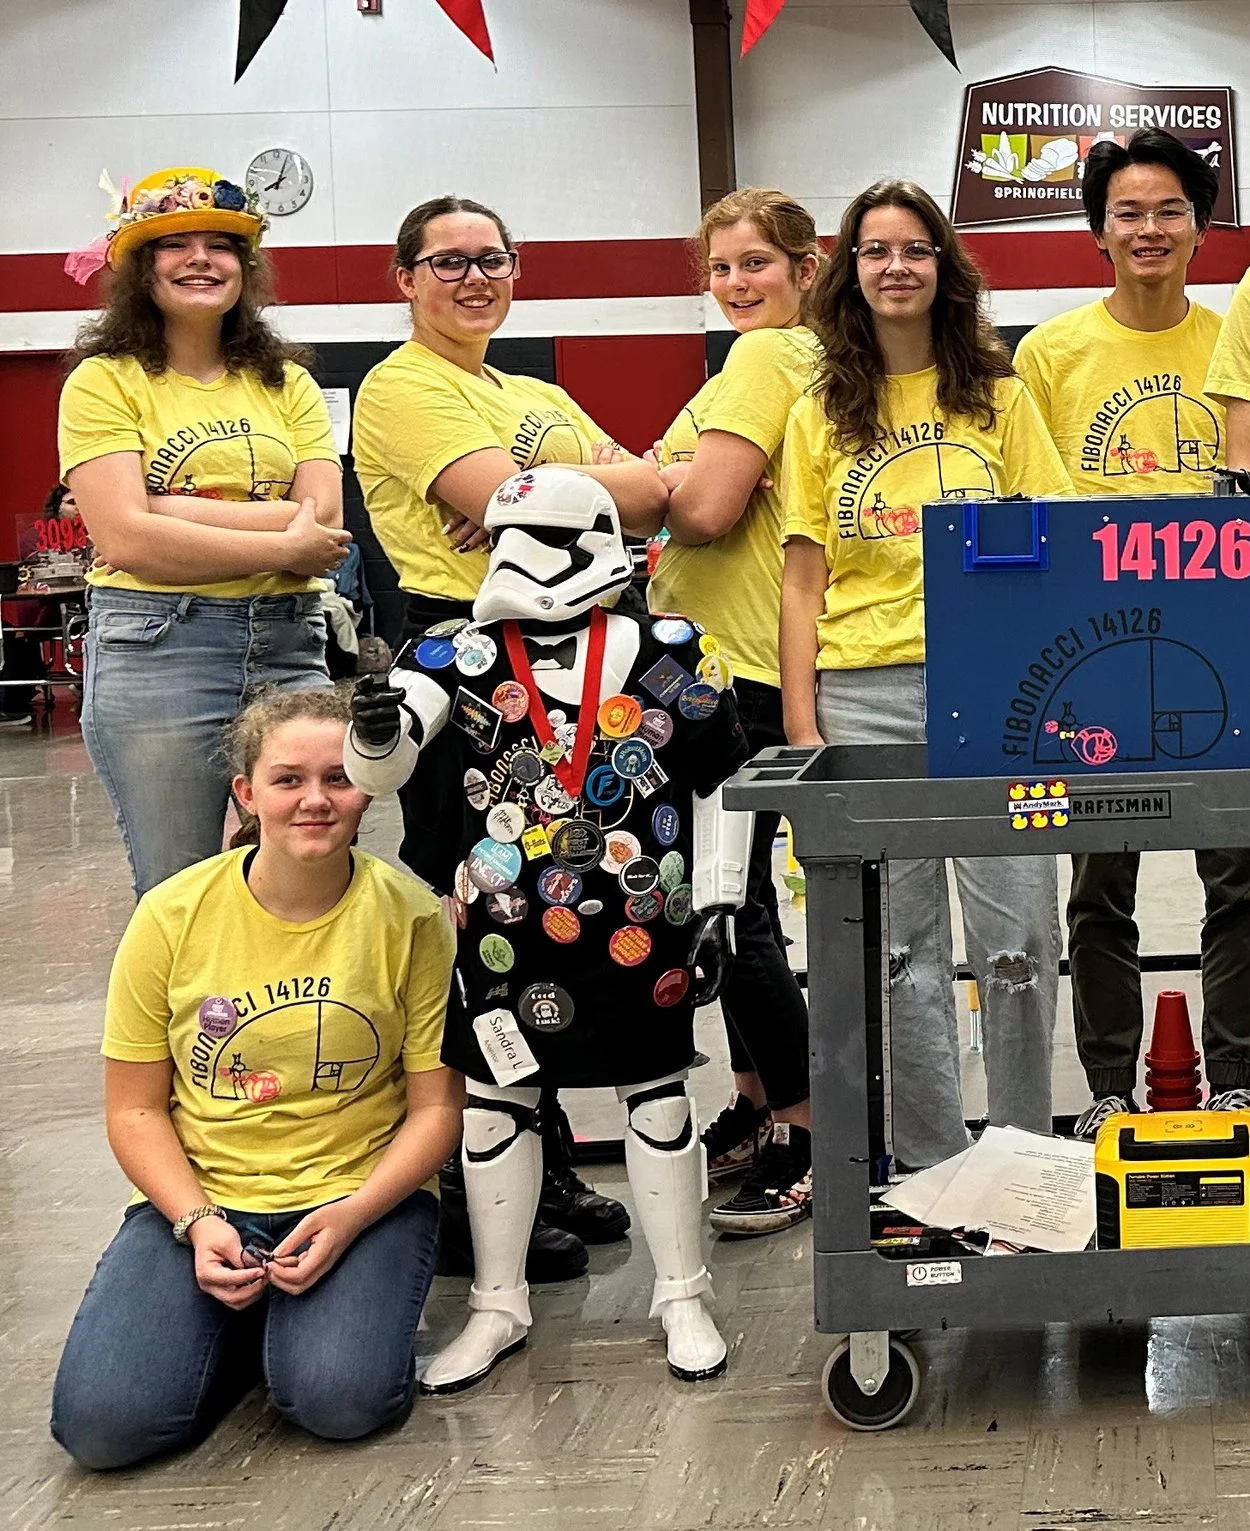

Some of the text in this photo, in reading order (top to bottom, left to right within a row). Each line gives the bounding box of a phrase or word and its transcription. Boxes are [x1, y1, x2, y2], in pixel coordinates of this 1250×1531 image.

[981, 102, 1222, 129] NUTRITION SERVICES
[994, 187, 1083, 199] SPRINGFIELD
[146, 417, 251, 495] BONACCI 14126
[1081, 373, 1181, 471] FIBONACCI 14126
[838, 422, 944, 540] FIBONACCI 14126
[1002, 607, 1162, 757] FIBONACCI 14126
[1070, 797, 1164, 815] RAFTSMAN
[190, 976, 332, 1090] FIBONCI 14126
[489, 1016, 517, 1060] Sandra
